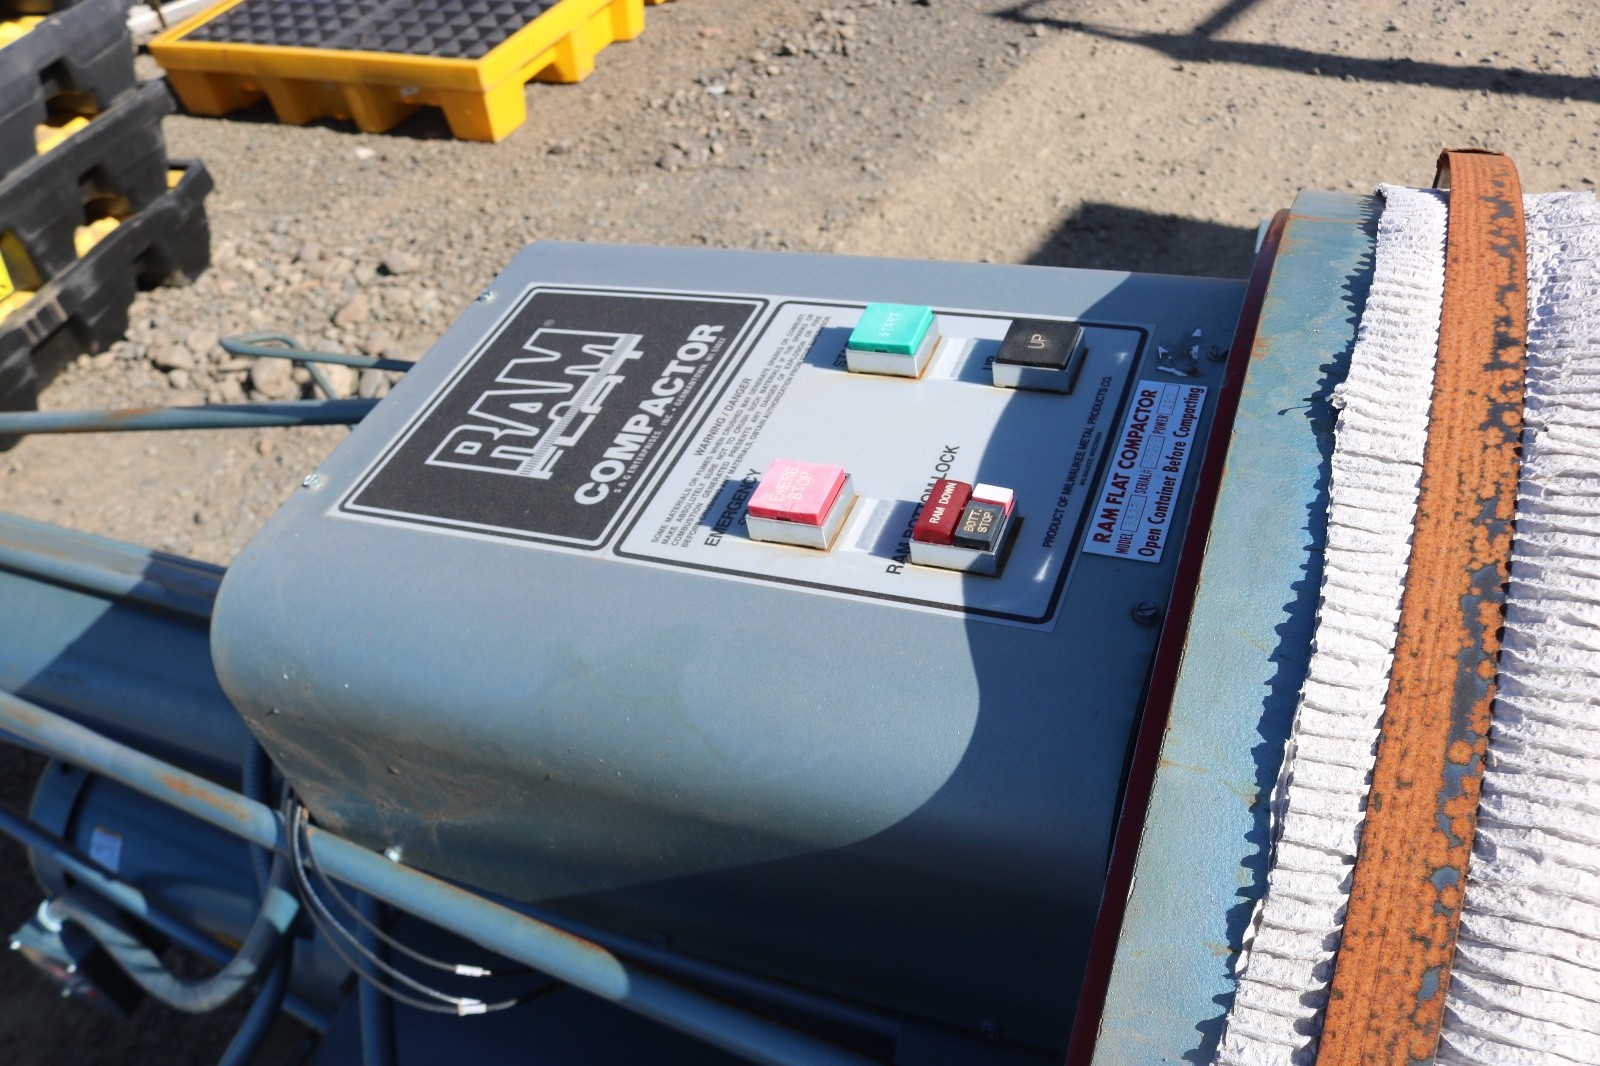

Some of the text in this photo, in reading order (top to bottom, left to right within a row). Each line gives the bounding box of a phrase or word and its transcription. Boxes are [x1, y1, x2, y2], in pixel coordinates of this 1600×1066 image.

[778, 337, 790, 345] OR
[877, 311, 901, 337] START
[1026, 333, 1048, 349] UP
[765, 346, 785, 366] SPARKS
[659, 412, 676, 425] INC.
[703, 353, 717, 361] WI
[746, 367, 771, 395] GENERATE
[423, 326, 627, 476] RAM
[522, 333, 645, 479] FLAT
[568, 322, 725, 506] COMPACTOR
[692, 416, 728, 456] WARNING
[722, 377, 754, 412] DANGER
[738, 396, 752, 407] MAY
[1171, 386, 1205, 438] Compacting
[660, 525, 679, 545] MAKE
[674, 482, 707, 522] ABSOLUTELY
[702, 462, 719, 479] SURE
[714, 447, 729, 460] NOT
[724, 435, 737, 444] TO
[731, 413, 751, 433] CRUSH
[745, 395, 762, 411] SUCH
[757, 364, 782, 394] MATERIALS
[782, 344, 795, 354] THE
[790, 323, 809, 342] SPARKS
[803, 313, 815, 321] OR
[670, 502, 705, 546] COMBUSTION
[700, 460, 731, 498] GENERATED
[726, 426, 753, 457] PRESENTS
[748, 410, 763, 423] ANY
[758, 383, 780, 407] DANGER
[775, 373, 787, 381] OF
[782, 339, 808, 369] EXPLOSION
[802, 329, 814, 337] OR
[720, 408, 744, 436] CRUSHED
[1115, 388, 1157, 470] COMPACTOR
[679, 520, 704, 548] BEFORE
[697, 487, 725, 520] CRUSHING
[717, 475, 732, 488] ANY
[747, 418, 768, 440] OBTAIN
[761, 375, 795, 418] AUTHORIZATION
[787, 360, 804, 376] FROM
[707, 436, 726, 454] WHEN
[930, 444, 959, 480] LOCK
[1041, 375, 1113, 548] PRODUCT OF MILWAUKEE METAL PRODUCTS CO.
[1160, 439, 1186, 473] Before
[687, 476, 700, 486] OR
[693, 455, 714, 476] FUMES
[766, 463, 802, 502] EMERG.
[787, 470, 816, 500] STOP
[1104, 471, 1131, 505] FLAT
[1115, 531, 1135, 554] MODEL
[1151, 414, 1170, 434] POWER
[1145, 474, 1176, 525] Container
[663, 487, 693, 523] MATERIALS
[702, 467, 763, 547] EMERGENCY
[928, 481, 957, 524] RAM DOWN
[962, 507, 983, 532] BOTT.
[650, 523, 670, 543] SOME
[975, 510, 995, 533] STOP
[1091, 506, 1120, 543] RAM
[1136, 526, 1165, 558] Open
